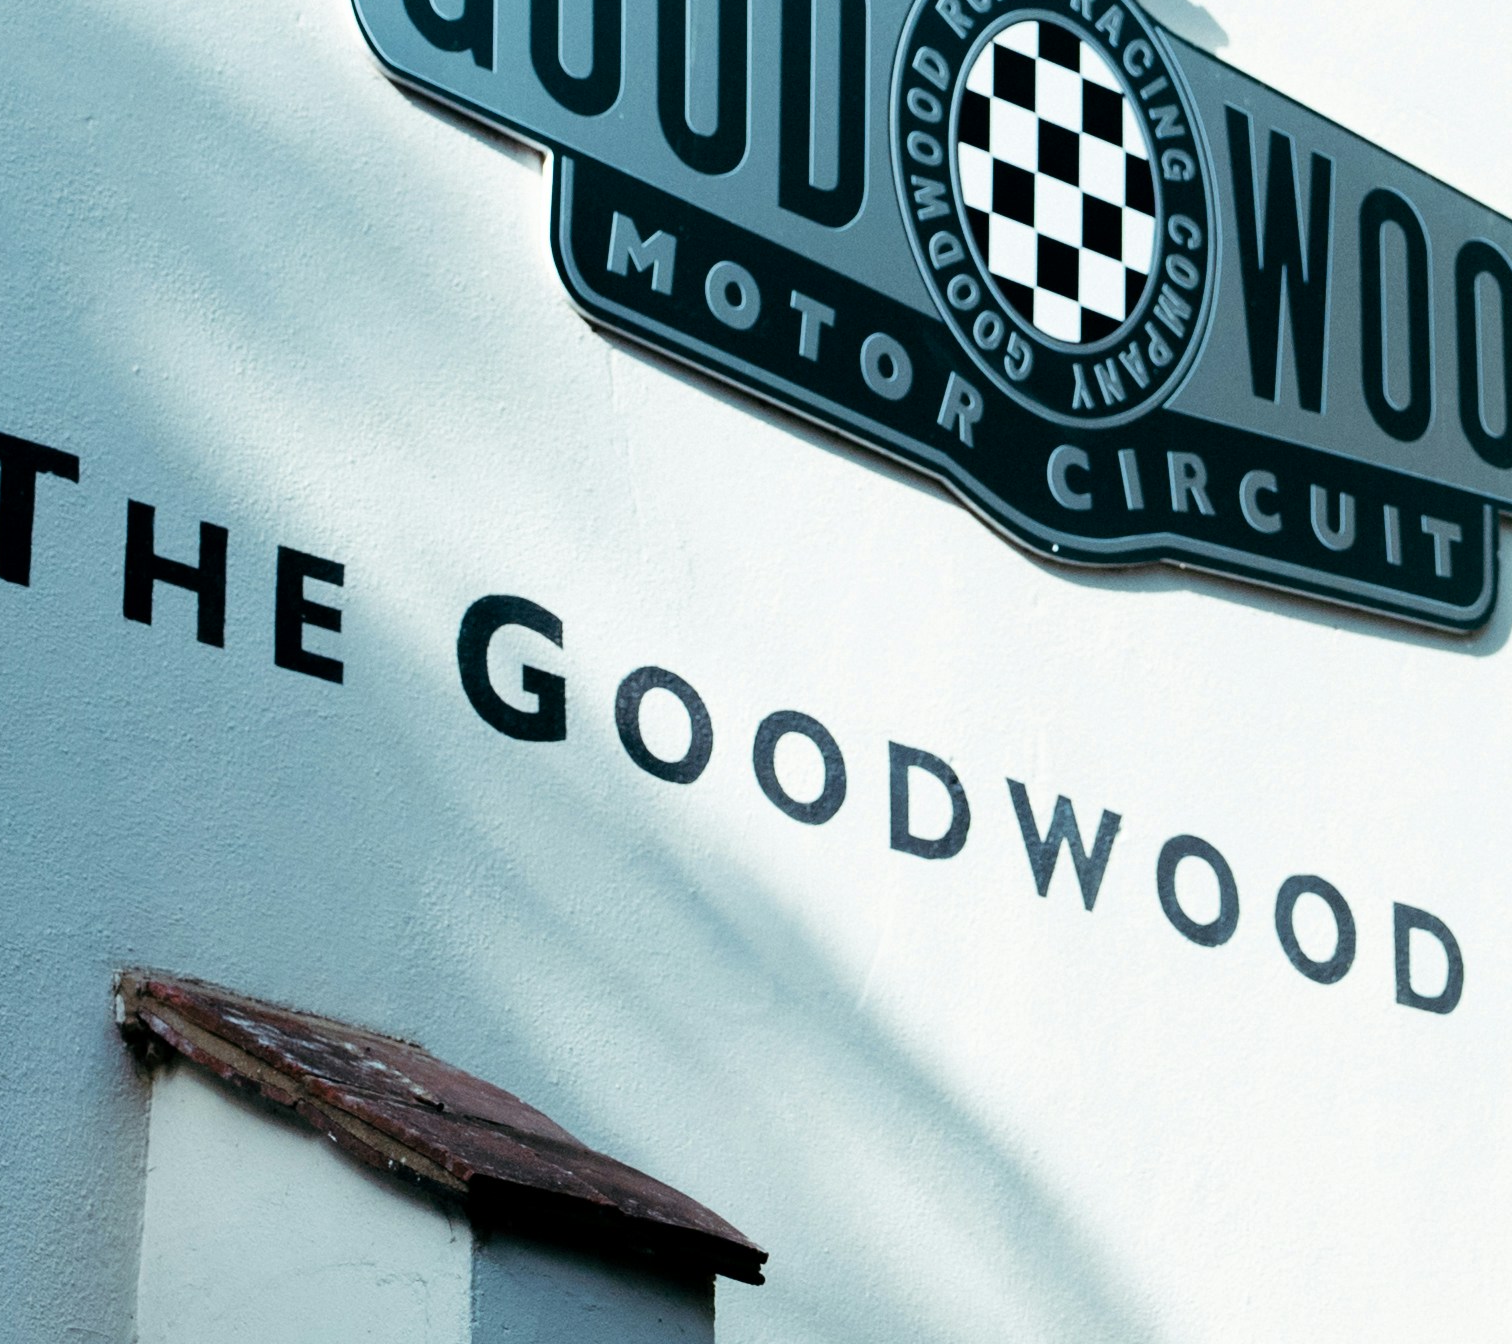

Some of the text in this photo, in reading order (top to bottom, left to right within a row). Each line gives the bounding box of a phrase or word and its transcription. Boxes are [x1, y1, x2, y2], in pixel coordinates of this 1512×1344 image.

[605, 212, 1463, 579] MOTOR CIRCUIT
[906, 46, 1034, 383] GOODWOOD
[1072, 213, 1202, 410] COMPANY
[455, 595, 1466, 1017] GOODWOOD
